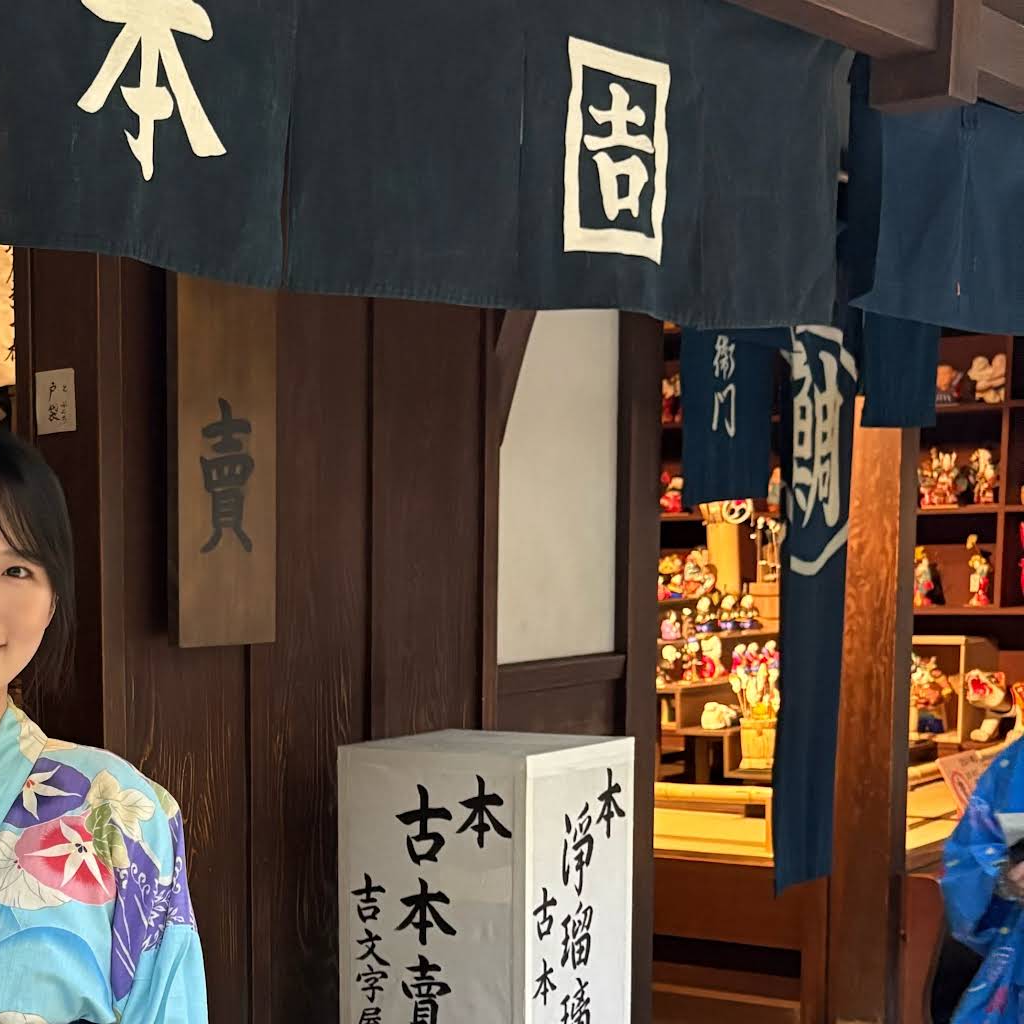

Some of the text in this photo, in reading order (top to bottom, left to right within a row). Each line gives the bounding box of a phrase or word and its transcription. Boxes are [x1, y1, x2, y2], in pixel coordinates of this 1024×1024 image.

[78, 0, 228, 181] 本
[455, 774, 513, 849] 本
[596, 768, 626, 839] 本
